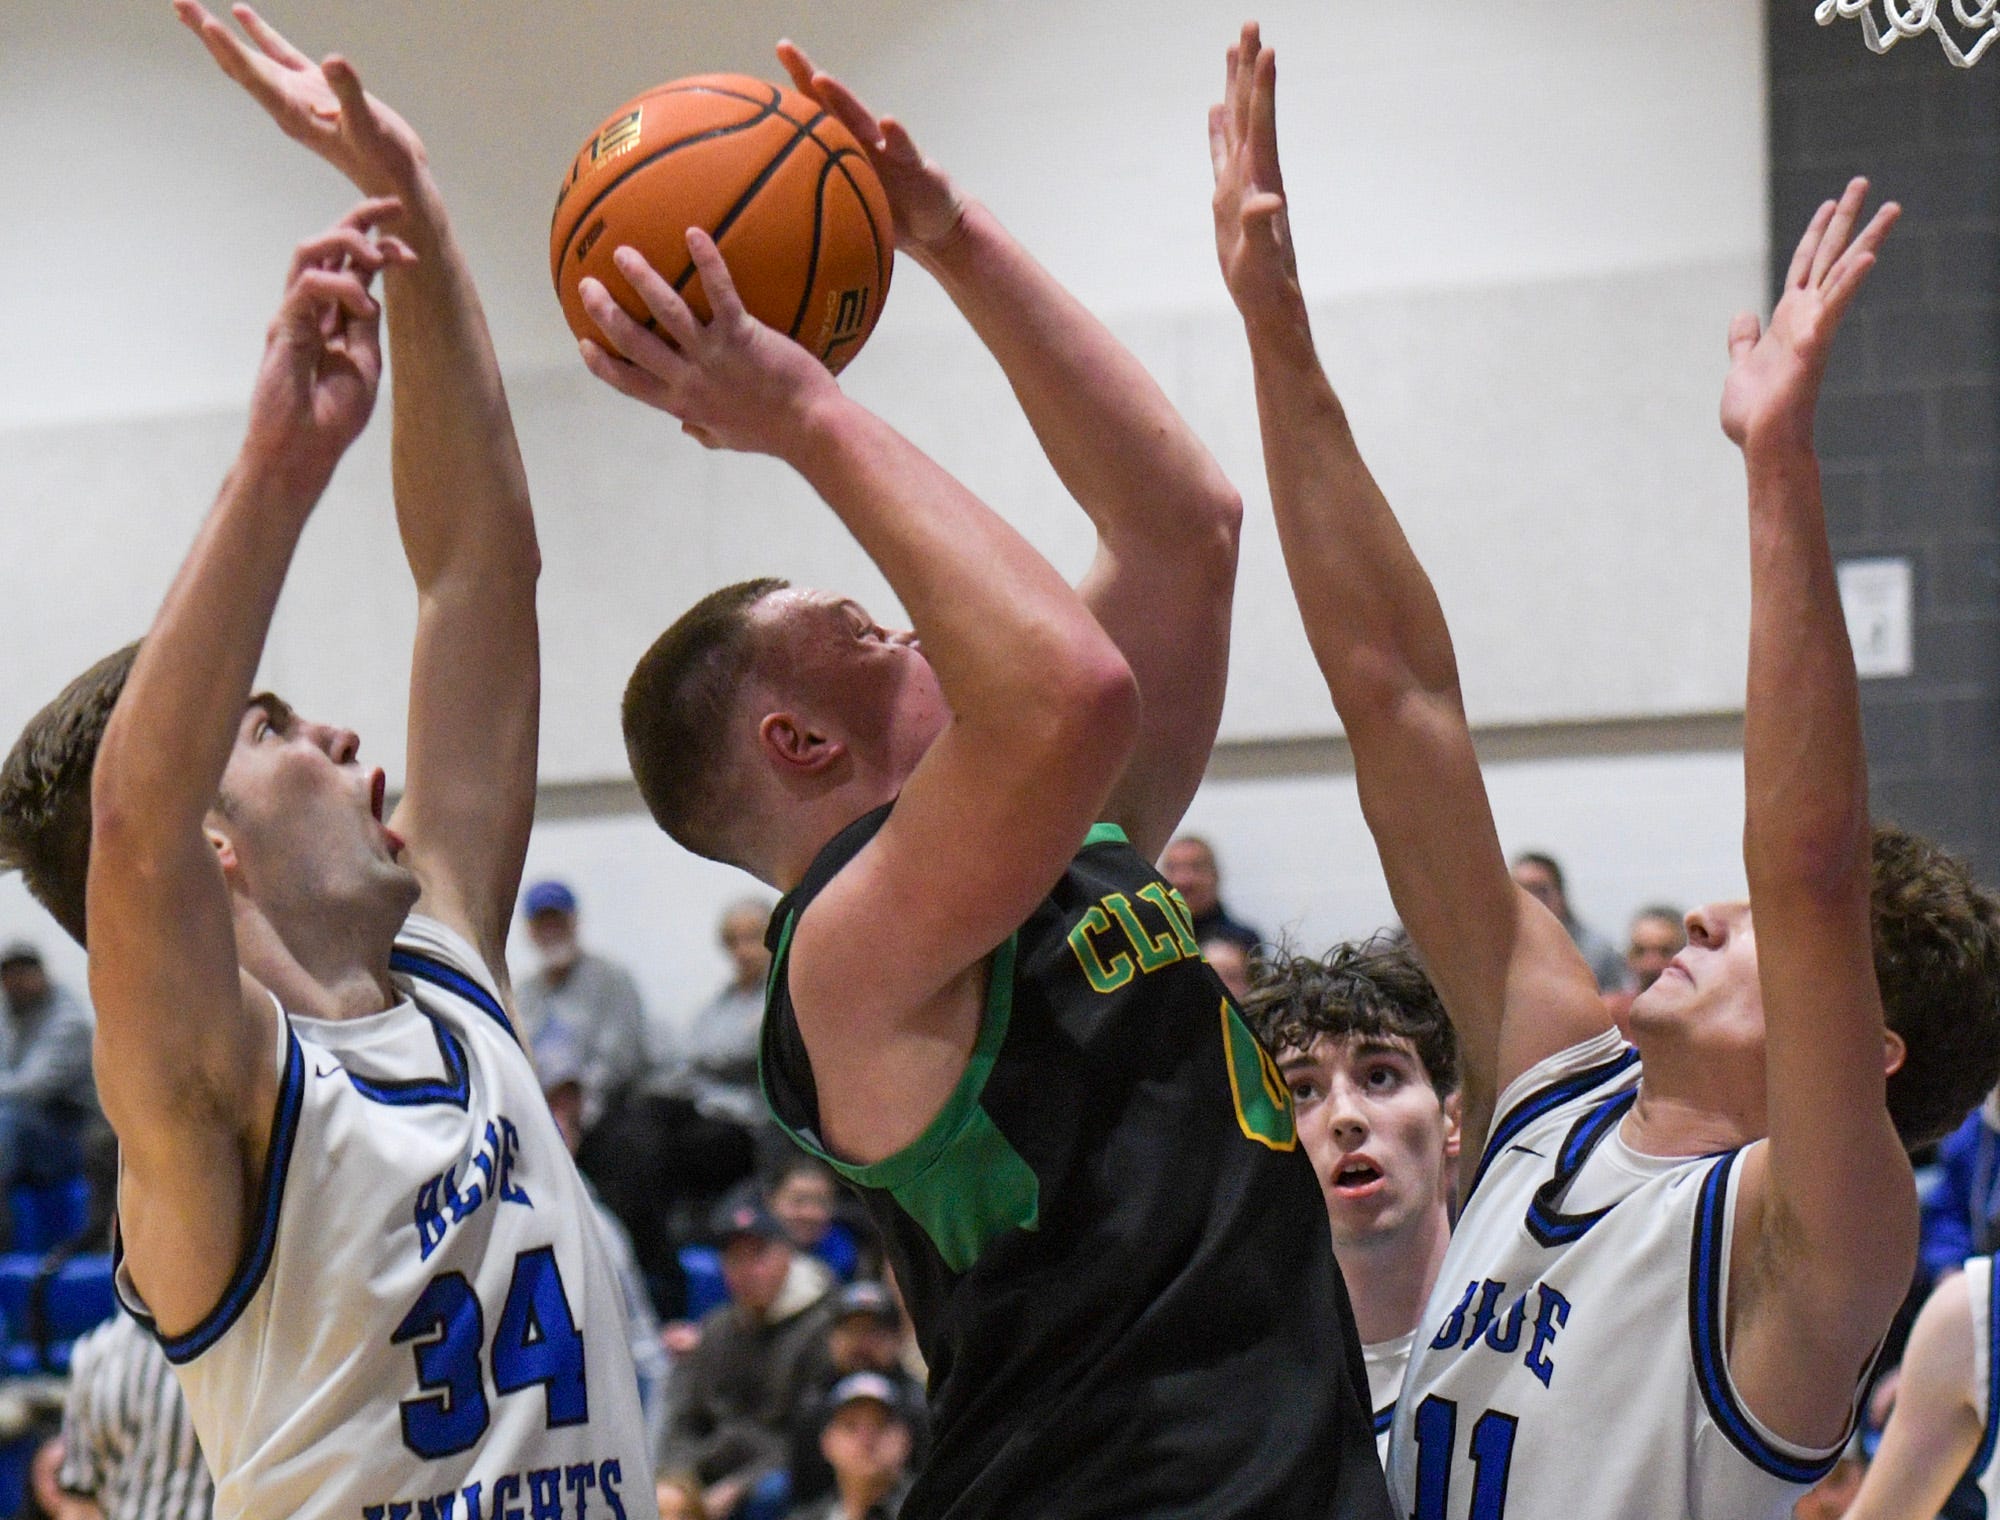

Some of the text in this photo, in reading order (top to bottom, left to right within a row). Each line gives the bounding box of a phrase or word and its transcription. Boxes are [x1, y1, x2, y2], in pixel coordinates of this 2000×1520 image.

[1067, 882, 1210, 993] CLI
[413, 1115, 534, 1263] BLUE
[390, 1246, 589, 1460] 34
[362, 1459, 628, 1520] GHTS
[1410, 1393, 1519, 1520] 11
